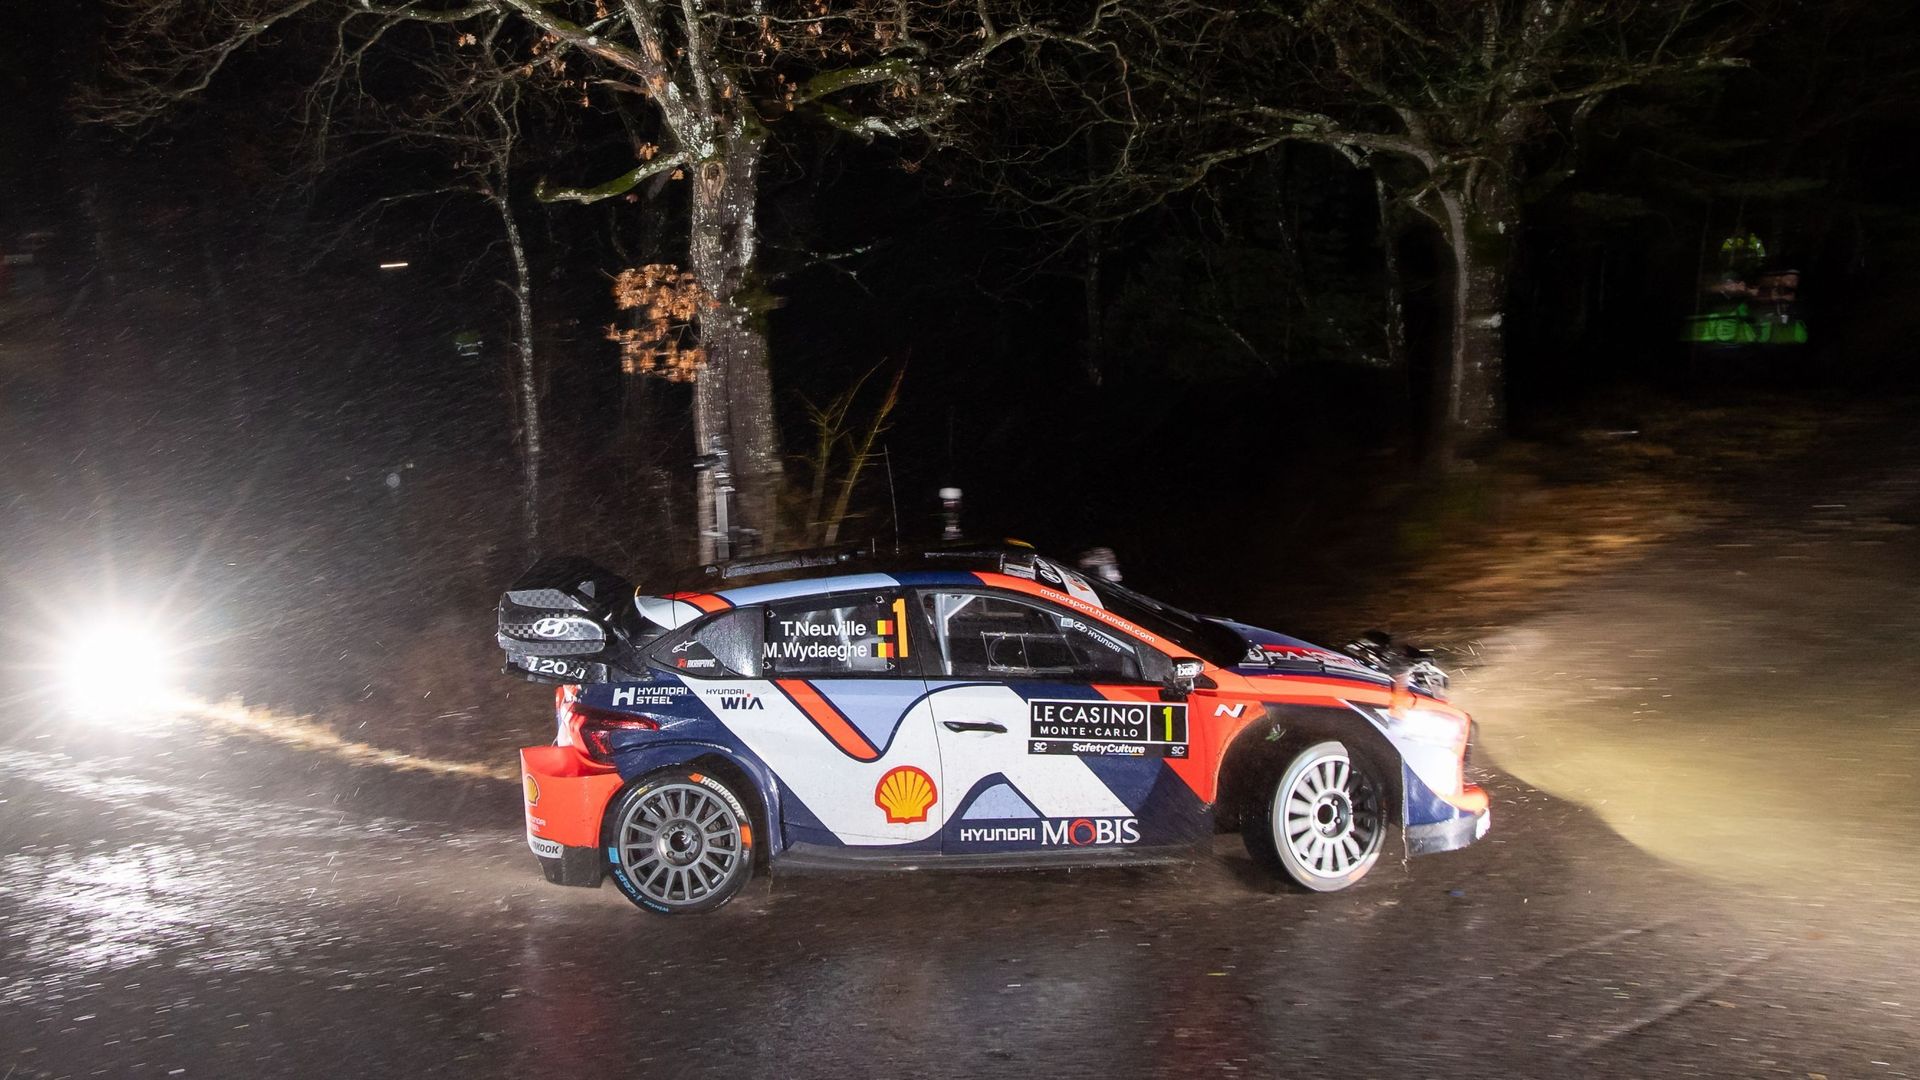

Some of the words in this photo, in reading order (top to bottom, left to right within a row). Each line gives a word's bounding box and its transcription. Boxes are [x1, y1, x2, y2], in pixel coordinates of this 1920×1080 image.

[1039, 588, 1156, 643] motorsport.hyundai.com
[780, 621, 867, 636] T.Neuville
[892, 598, 909, 658] 1
[1088, 630, 1121, 653] HYUNDAI
[763, 642, 868, 662] M.Wydaeghe
[636, 696, 673, 705] STEEL
[637, 687, 688, 695] HYUNDAI
[1033, 705, 1055, 722] LE
[1059, 705, 1145, 725] CASINO
[1162, 706, 1174, 742] 1
[1033, 742, 1048, 752] SC
[1072, 742, 1146, 754] SafetyCulture
[1171, 746, 1185, 754] SC
[960, 828, 1036, 842] HYUNDAI
[1041, 818, 1141, 845] MOBIS
